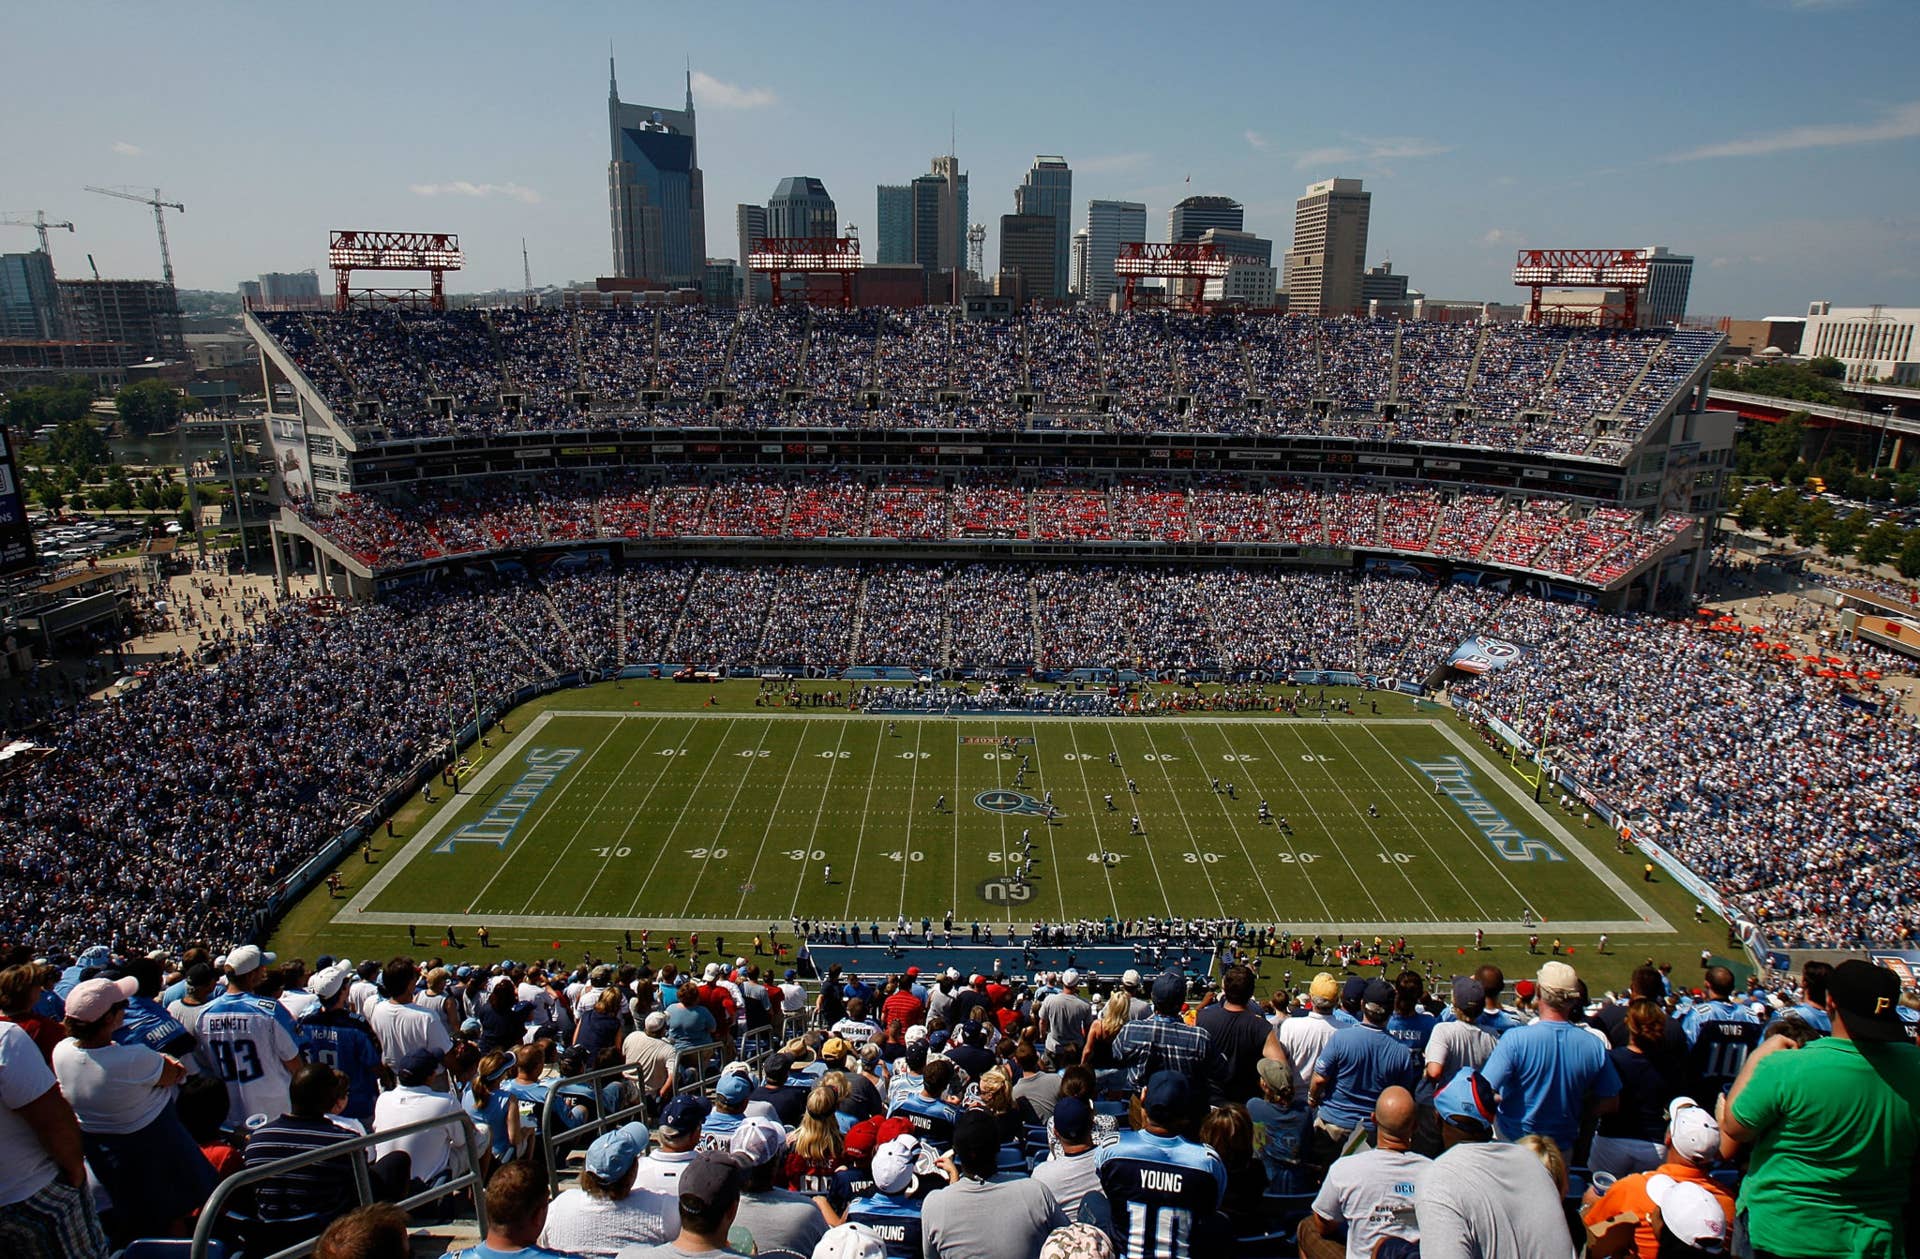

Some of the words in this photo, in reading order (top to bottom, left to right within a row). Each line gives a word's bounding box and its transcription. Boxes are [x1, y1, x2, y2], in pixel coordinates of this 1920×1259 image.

[280, 420, 294, 438] LP
[661, 748, 688, 756] 10
[740, 750, 772, 758] 20
[821, 751, 852, 759] 30
[902, 751, 932, 760] 40
[983, 752, 1012, 760] 50
[1064, 753, 1094, 761] 40
[1144, 753, 1174, 761] 30
[1222, 754, 1255, 762] 20
[1301, 754, 1330, 762] 10
[434, 748, 583, 853] TITANS
[1406, 755, 1566, 862] TITANS
[597, 847, 632, 858] 10
[691, 848, 728, 860] 20
[789, 849, 826, 861] 30
[888, 850, 925, 863] 40
[987, 852, 1023, 863] 50
[1086, 852, 1121, 864] 40
[1183, 852, 1220, 864] 30
[1278, 852, 1316, 864] 20
[1376, 852, 1410, 864] 10
[985, 883, 1030, 900] GU
[1874, 996, 1889, 1014] P
[210, 1018, 248, 1031] BENNETT
[312, 1029, 338, 1040] McNAIR
[909, 1115, 932, 1130] YOUNG
[1140, 1169, 1183, 1193] YOUNG
[872, 1225, 905, 1241] YOUNG
[1127, 1200, 1192, 1259] 10
